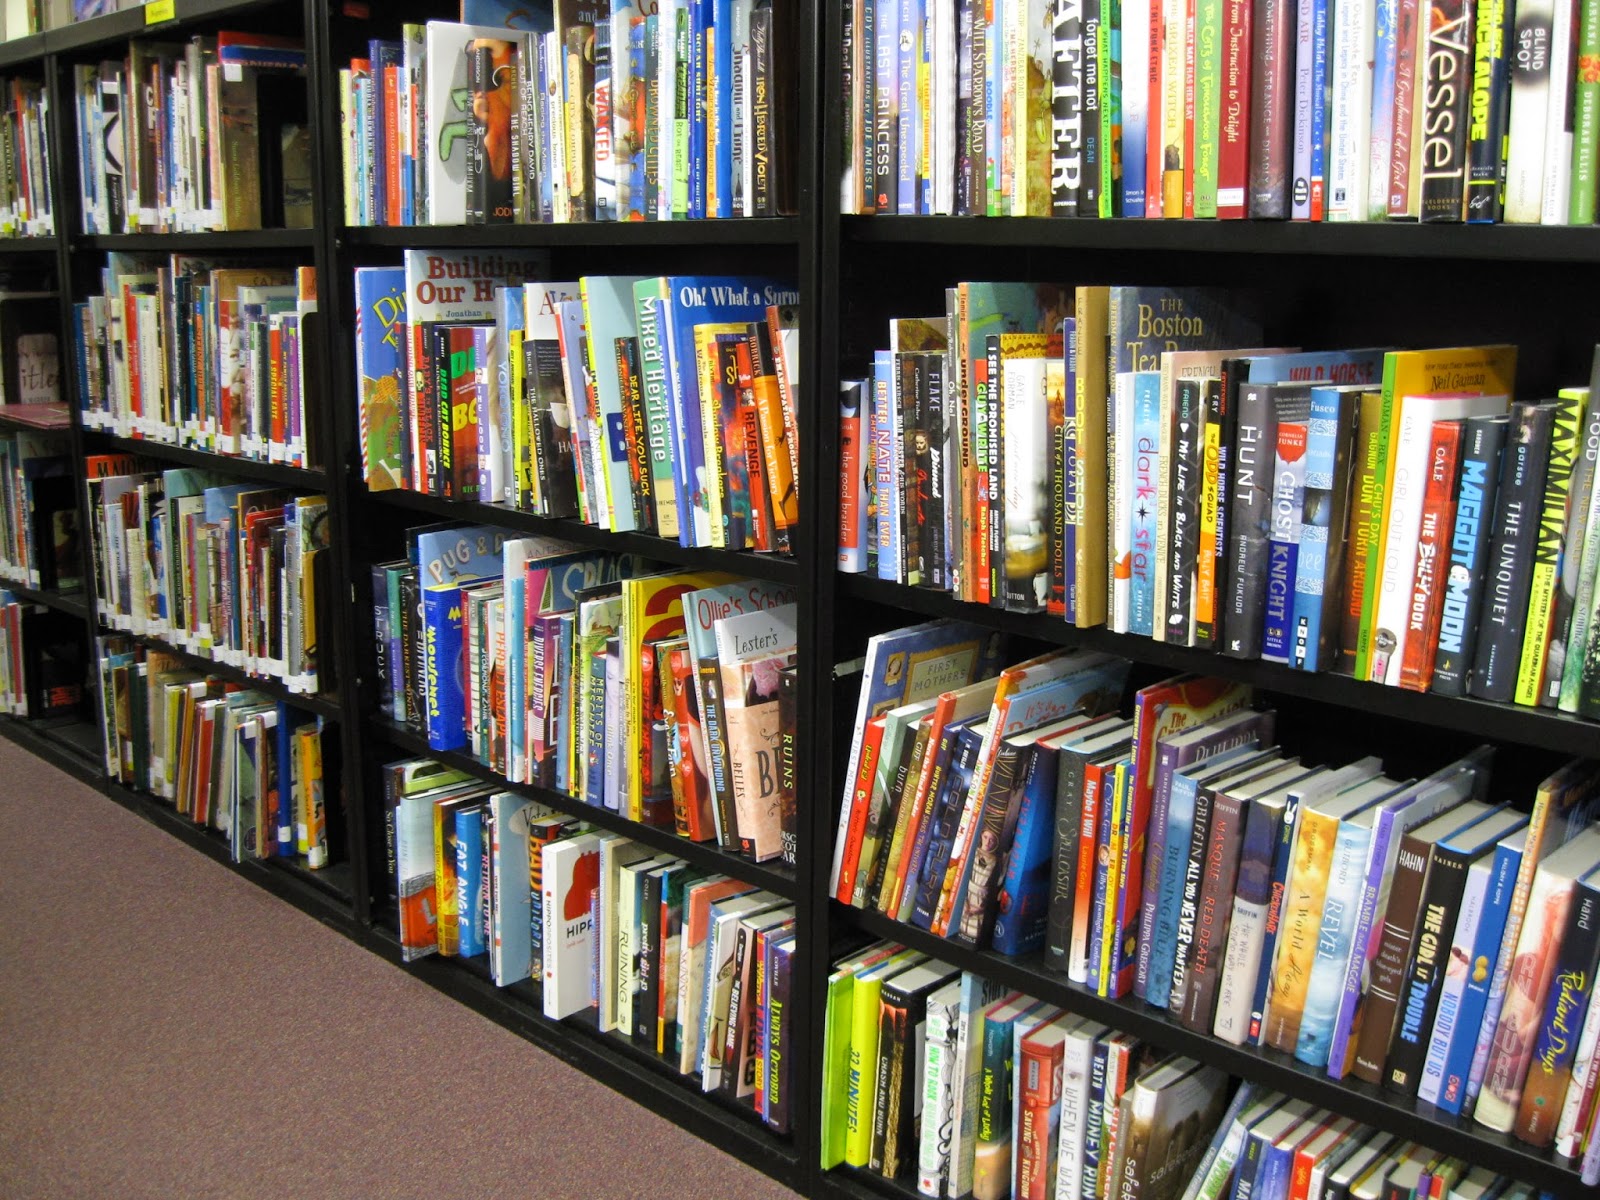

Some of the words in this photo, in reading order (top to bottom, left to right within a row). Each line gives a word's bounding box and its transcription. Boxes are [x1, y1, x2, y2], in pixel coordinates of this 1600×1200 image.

[880, 14, 888, 29] THE
[973, 18, 985, 51] WILL
[1084, 19, 1099, 59] forget
[1300, 20, 1309, 44] AIR
[878, 34, 889, 78] LAST
[1517, 28, 1531, 71] SPOT
[1532, 28, 1546, 71] BLIND
[901, 57, 911, 79] The
[973, 53, 985, 117] SPARROW'S
[1086, 63, 1097, 84] me
[1299, 68, 1308, 95] Peter
[900, 82, 911, 112] Great
[1051, 0, 1082, 195] AFTER
[1086, 89, 1098, 111] not
[1422, 11, 1469, 183] Vessel
[596, 85, 610, 161] WANTED
[877, 87, 889, 176] PRINCESS
[1298, 99, 1308, 154] Dickinson
[1580, 91, 1592, 144] DEBORAH
[511, 135, 519, 171] SHADOW
[900, 117, 910, 181] Unexpected
[973, 120, 986, 153] ROAD
[1086, 137, 1094, 163] DEAN
[1578, 148, 1590, 182] ELLIS
[416, 280, 465, 304] Our
[680, 286, 707, 307] Oh!
[711, 286, 749, 306] What
[753, 290, 761, 306] a
[1160, 299, 1184, 312] THE
[445, 309, 482, 317] Jonathan
[639, 296, 661, 362] Mixed
[1110, 300, 1118, 348] FREEDMAN
[1137, 303, 1203, 339] Boston
[748, 335, 761, 378] BOBRICK
[988, 354, 998, 378] SEE
[439, 368, 448, 399] DEAD
[929, 373, 940, 412] FLAKE
[988, 380, 998, 401] THE
[1109, 356, 1117, 395] MALONE
[1430, 370, 1452, 392] Neil
[1453, 371, 1486, 392] Gaiman
[440, 401, 450, 422] CAT
[529, 386, 537, 406] THE
[758, 398, 767, 406] A
[877, 381, 888, 425] BETTER
[1181, 389, 1190, 419] FRIEND
[1380, 389, 1392, 433] GAIMAN
[532, 408, 543, 455] HALLOWED
[647, 369, 667, 462] Heritage
[760, 406, 771, 443] Passion
[442, 423, 450, 469] BOUNCE
[744, 411, 760, 479] REVENGE
[765, 446, 774, 459] for
[989, 403, 999, 471] PROMISED
[1054, 425, 1063, 453] CITY
[1178, 440, 1189, 461] MY
[1377, 444, 1388, 465] REX
[1473, 429, 1483, 455] GARDNER
[538, 457, 546, 481] ONES
[842, 451, 852, 469] the
[877, 430, 891, 483] NATE
[929, 447, 942, 499] Pinned
[1136, 437, 1156, 501] dark
[1236, 425, 1257, 505] HUNT
[1433, 447, 1445, 481] GALE
[1514, 447, 1528, 486] garsee
[766, 460, 778, 495] Victory
[840, 472, 852, 500] good
[989, 475, 999, 500] LAND
[1177, 464, 1187, 491] LIFE
[1394, 467, 1409, 505] GIRL
[1535, 395, 1579, 564] MAXIMILIAN
[879, 487, 889, 518] THAN
[1053, 468, 1062, 535] THOUSAND
[1176, 496, 1185, 506] IN
[1274, 471, 1296, 542] GHOST
[1371, 483, 1384, 518] CHU'S
[1449, 460, 1486, 570] MAGGOT
[840, 502, 851, 543] braider
[880, 521, 890, 547] EVER
[1173, 512, 1186, 548] BLACK
[1369, 521, 1381, 546] DAY
[1390, 509, 1404, 542] OUT
[1503, 502, 1522, 536] THE
[1054, 540, 1063, 577] DOLLS
[1134, 529, 1153, 583] star
[1173, 551, 1182, 571] AND
[1237, 535, 1247, 574] ANDREW
[1383, 547, 1400, 593] LOUD
[1171, 574, 1183, 610] WHITE
[1235, 577, 1245, 614] FUKUDA
[1268, 544, 1289, 621] KNIGHT
[1491, 543, 1518, 626] UNQUIET
[698, 594, 744, 632] Ollie's
[1437, 580, 1466, 653] MOON
[734, 627, 779, 655] Lester's
[912, 668, 968, 692] MOTHERS
[926, 658, 959, 676] FIRST
[595, 678, 604, 726] MERITS
[706, 704, 716, 719] THE
[595, 732, 604, 749] OF
[708, 720, 720, 742] DARK
[711, 743, 725, 792] UNWINDING
[783, 733, 793, 790] RUINS
[895, 765, 908, 793] burn
[732, 762, 745, 799] BELLES
[386, 811, 393, 822] So
[1191, 795, 1210, 860] GRIFFIN
[386, 824, 394, 847] Close
[1208, 820, 1228, 881] MASQUE
[456, 840, 467, 871] FAT
[1186, 859, 1200, 881] ALL
[1337, 838, 1354, 885] GUIBORD
[1398, 850, 1424, 872] HAHN
[1183, 882, 1197, 899] YOU
[1140, 902, 1156, 941] PHILIPPA
[1176, 899, 1195, 942] NEVER
[1202, 895, 1217, 925] RED
[1577, 898, 1593, 930] Hand
[1316, 899, 1344, 961] REVEL
[619, 930, 629, 1004] RUINING
[1137, 943, 1152, 985] GREGORY
[1172, 943, 1188, 986] WANTED
[1194, 927, 1212, 975] DEATH
[1551, 971, 1586, 1036] Radiant
[770, 998, 783, 1046] ALWAYS
[880, 1057, 888, 1088] CRASH
[1092, 1056, 1105, 1089] HEATH
[1539, 1034, 1567, 1077] Days
[769, 1049, 781, 1104] OCTOBER
[876, 1111, 884, 1136] BURN
[1023, 1110, 1033, 1143] SAVING
[1063, 1087, 1079, 1134] WHEN
[1084, 1098, 1104, 1162] MONEY
[1061, 1138, 1076, 1161] WE
[1021, 1158, 1031, 1199] KINGDOM
[1081, 1165, 1098, 1198] RUN
